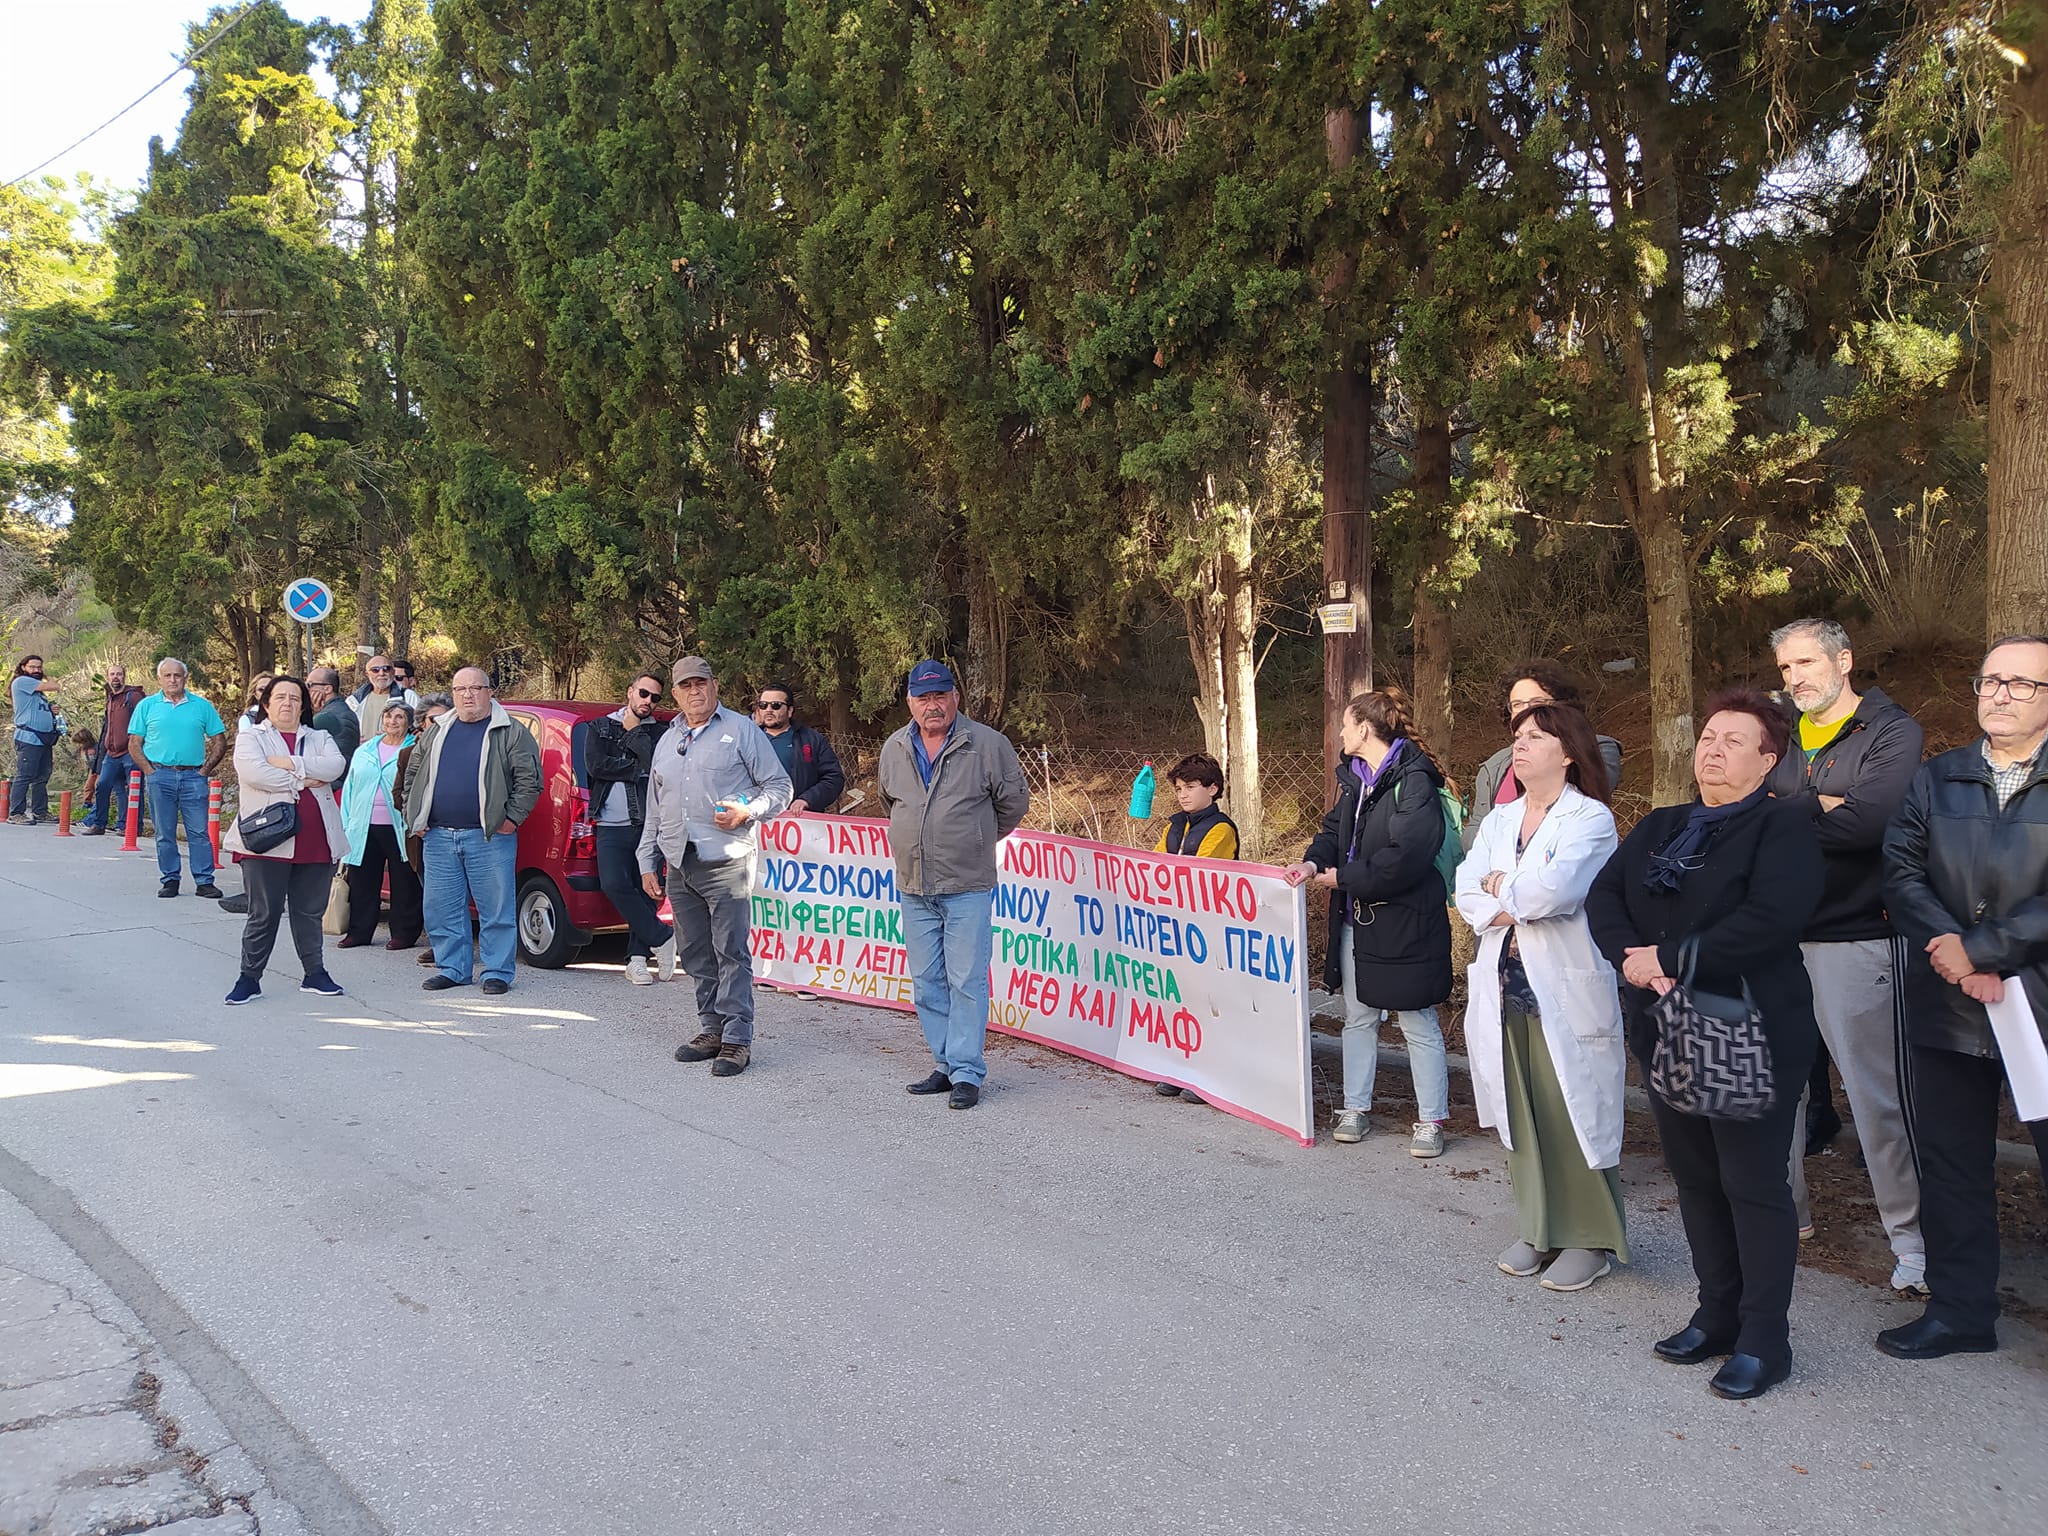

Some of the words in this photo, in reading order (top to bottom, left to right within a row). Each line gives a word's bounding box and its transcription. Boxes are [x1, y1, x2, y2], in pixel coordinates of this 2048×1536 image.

[764, 858, 901, 903] ΝΟΣΟΚΟΜ
[1074, 894, 1104, 936] ΤΟ
[1114, 903, 1208, 964] ΙΑΤΡΕΙΟ
[826, 824, 895, 858] ΙΑΤΡΙ
[1003, 840, 1077, 885] ΛΟΙΠΟ
[1093, 851, 1257, 922] ΠΡΟΣΩΠΙΚΟ
[751, 895, 905, 945] ΠΕΡΙΦΕΡΕΙΑΚ
[1094, 948, 1182, 1003] ΙΑΤΡΕΙΑ
[793, 935, 845, 966] ΚΑΙ
[1008, 967, 1061, 1016] ΜΕΘ
[1068, 982, 1117, 1029] ΚΑΙ
[1127, 997, 1202, 1060] ΜΑΦ
